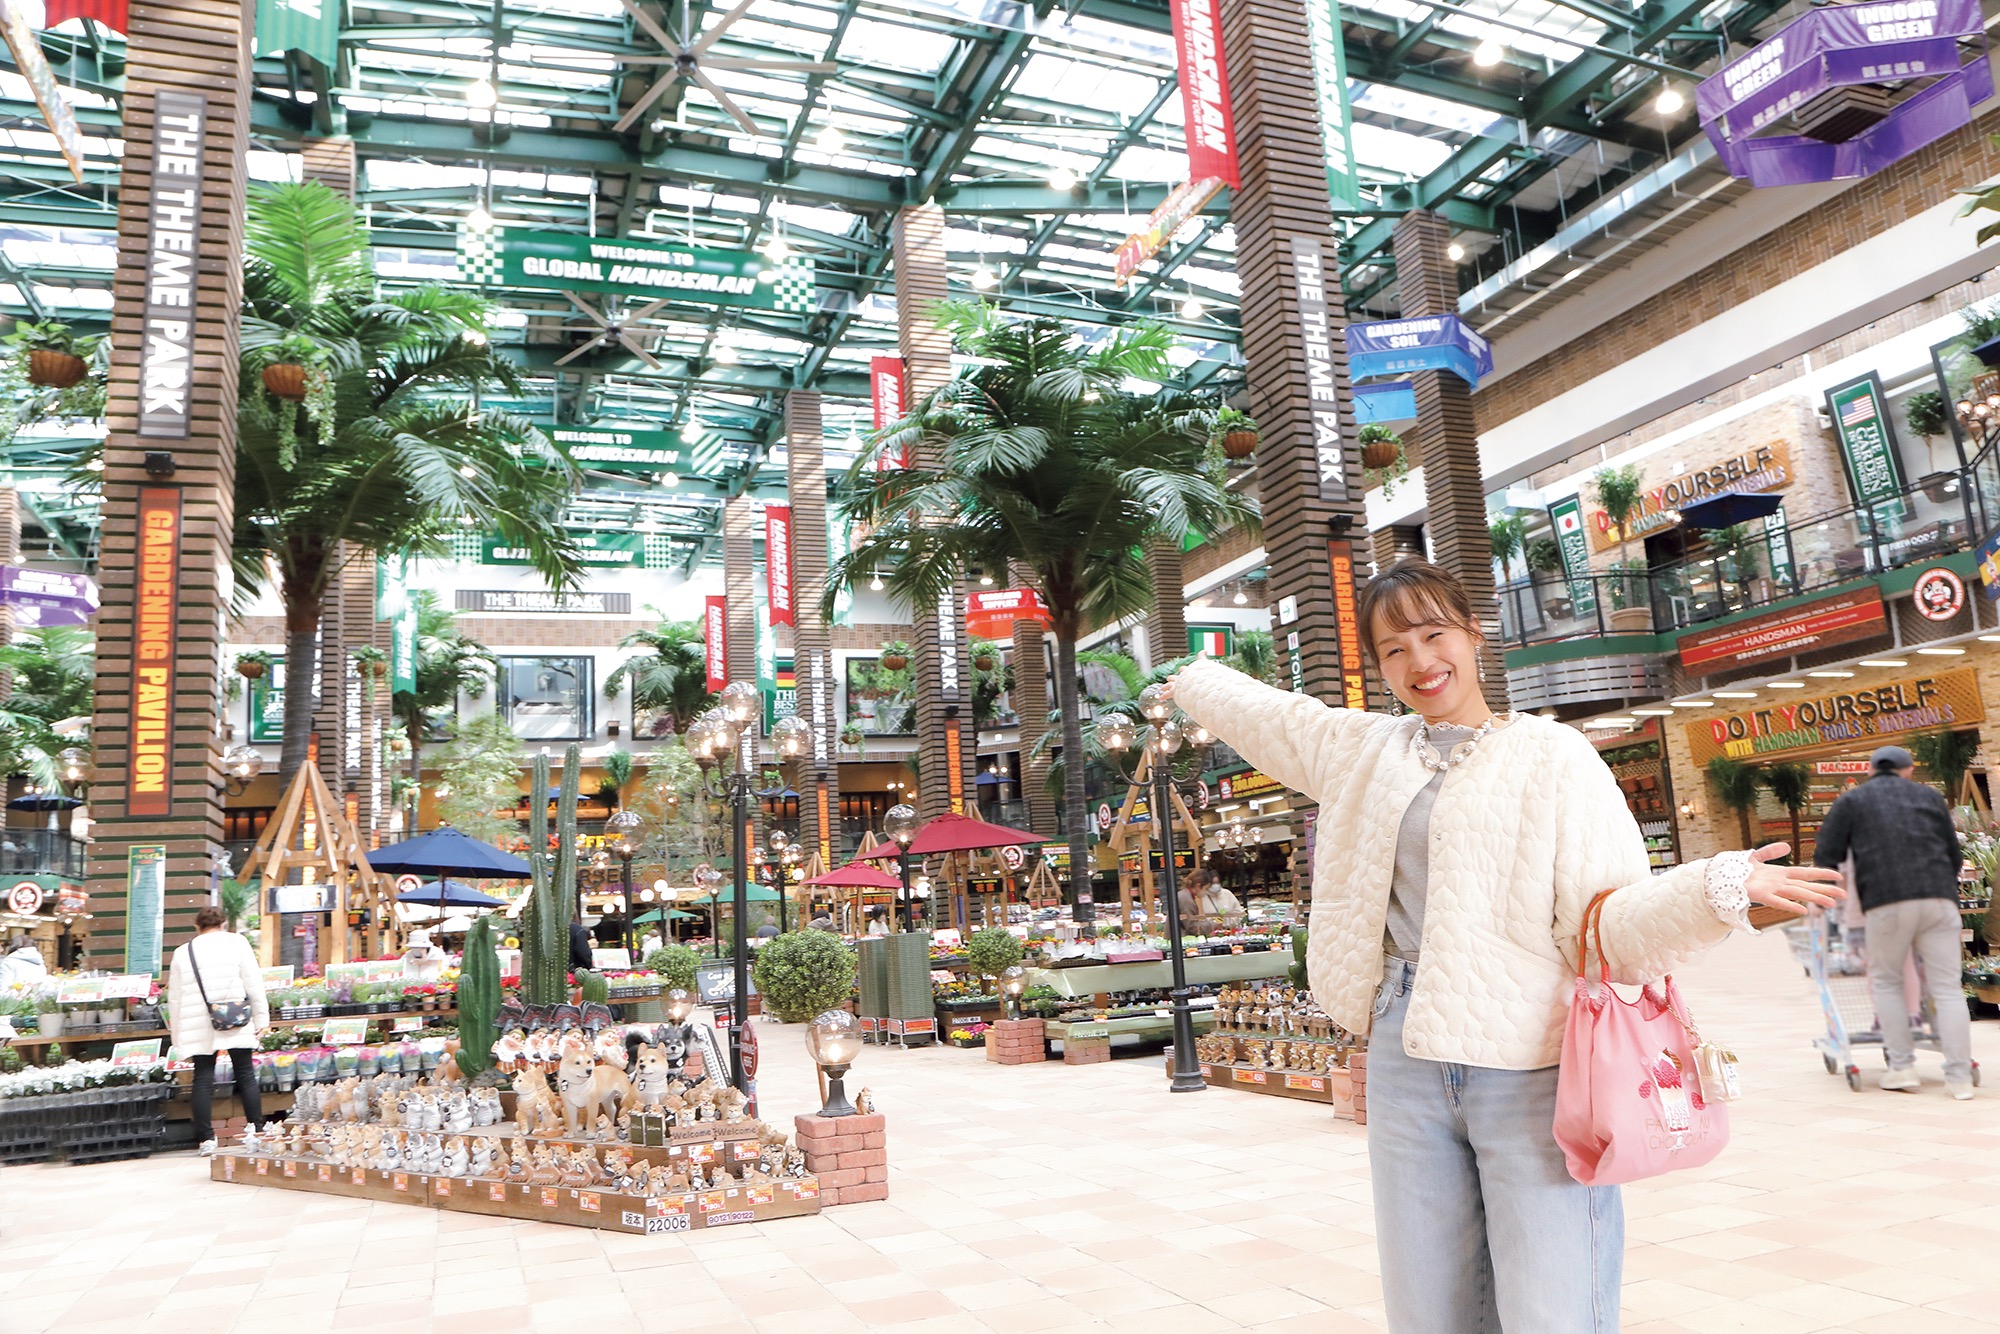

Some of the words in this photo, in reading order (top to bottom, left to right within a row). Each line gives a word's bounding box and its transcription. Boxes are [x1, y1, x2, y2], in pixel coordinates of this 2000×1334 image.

[1856, 1, 1938, 25] INDOOR
[1866, 19, 1934, 42] GREEN
[1187, 0, 1228, 155] ANDSMAN
[1724, 38, 1784, 88] INDOOR
[1731, 59, 1782, 101] GREEN
[1307, 0, 1348, 175] HANDSMAN
[159, 114, 199, 176] THE
[151, 189, 195, 307] THEME
[590, 244, 671, 265] WELCOME
[672, 252, 694, 267] TO
[523, 257, 604, 281] GLOBAL
[608, 264, 756, 295] HANDSMAN
[1296, 254, 1323, 302] THE
[1366, 318, 1441, 338] GARDENING
[1389, 334, 1421, 349] SOIL
[145, 319, 188, 415] PARK
[1303, 311, 1335, 402] THEME
[553, 430, 615, 444] WELCOME
[614, 433, 632, 445] TO
[1314, 410, 1343, 483] PARK
[1866, 422, 1882, 452] THE
[1875, 454, 1893, 489] BEST
[1650, 445, 1774, 511] YOURSELF
[1855, 427, 1882, 493] GARDEN
[140, 509, 174, 660] GARDENING
[771, 519, 790, 610] HANDSMAN
[484, 592, 511, 607] THE
[566, 594, 606, 609] PARK
[1332, 556, 1361, 670] GARDENING
[710, 605, 724, 680] HANDSMAN
[1744, 623, 1807, 647] HANDSMAN
[811, 655, 824, 679] THE
[940, 646, 959, 690] PARK
[1290, 653, 1303, 694] TOIL
[346, 682, 362, 728] THEME
[811, 681, 826, 724] THEME
[1710, 715, 1747, 744] DO
[1750, 709, 1774, 737] IT
[1780, 678, 1937, 731] YOURSELF
[135, 667, 168, 792] PAVILION
[346, 731, 361, 768] PARK
[814, 727, 828, 761] PARK
[1724, 738, 1754, 758] WITH
[1754, 726, 1820, 754] HANDSMAN
[1821, 719, 1862, 743] TOOLS
[1864, 719, 1876, 735] &
[1878, 703, 1955, 734] MATERIALS
[946, 729, 964, 795] GARDENING
[1820, 761, 1870, 773] HANDSMA
[818, 789, 829, 839] GARDENING
[673, 1128, 712, 1140] Welcome
[718, 1126, 757, 1136] Welcome
[624, 1213, 642, 1226] 坂本
[648, 1216, 688, 1233] 22006
[708, 1213, 731, 1224] 90121
[732, 1211, 754, 1220] 90122
